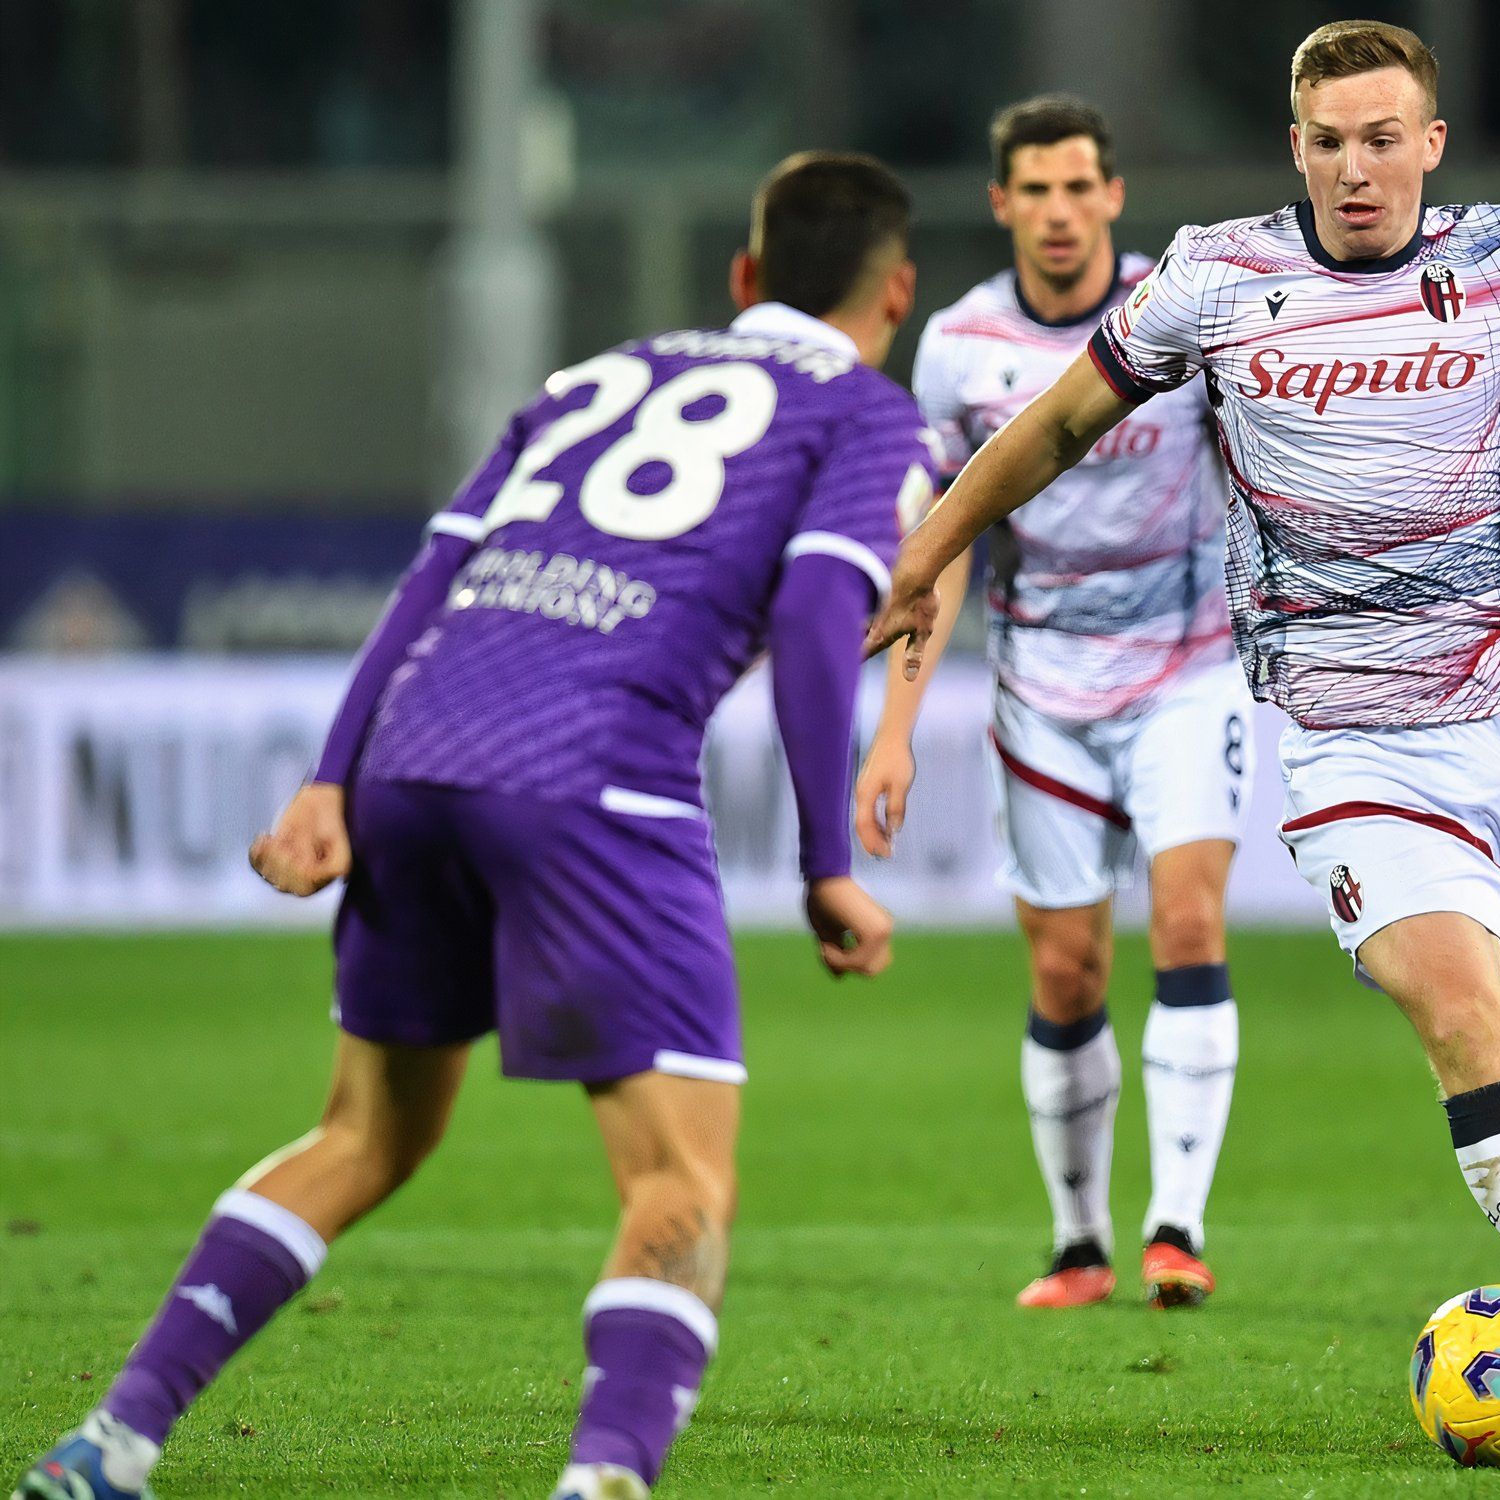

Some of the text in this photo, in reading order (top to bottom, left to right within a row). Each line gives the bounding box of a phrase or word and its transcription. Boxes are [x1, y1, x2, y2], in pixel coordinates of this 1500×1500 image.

[1426, 264, 1450, 279] BFC
[1237, 342, 1485, 416] Saputo
[479, 352, 779, 543] 28
[1224, 712, 1245, 776] 8
